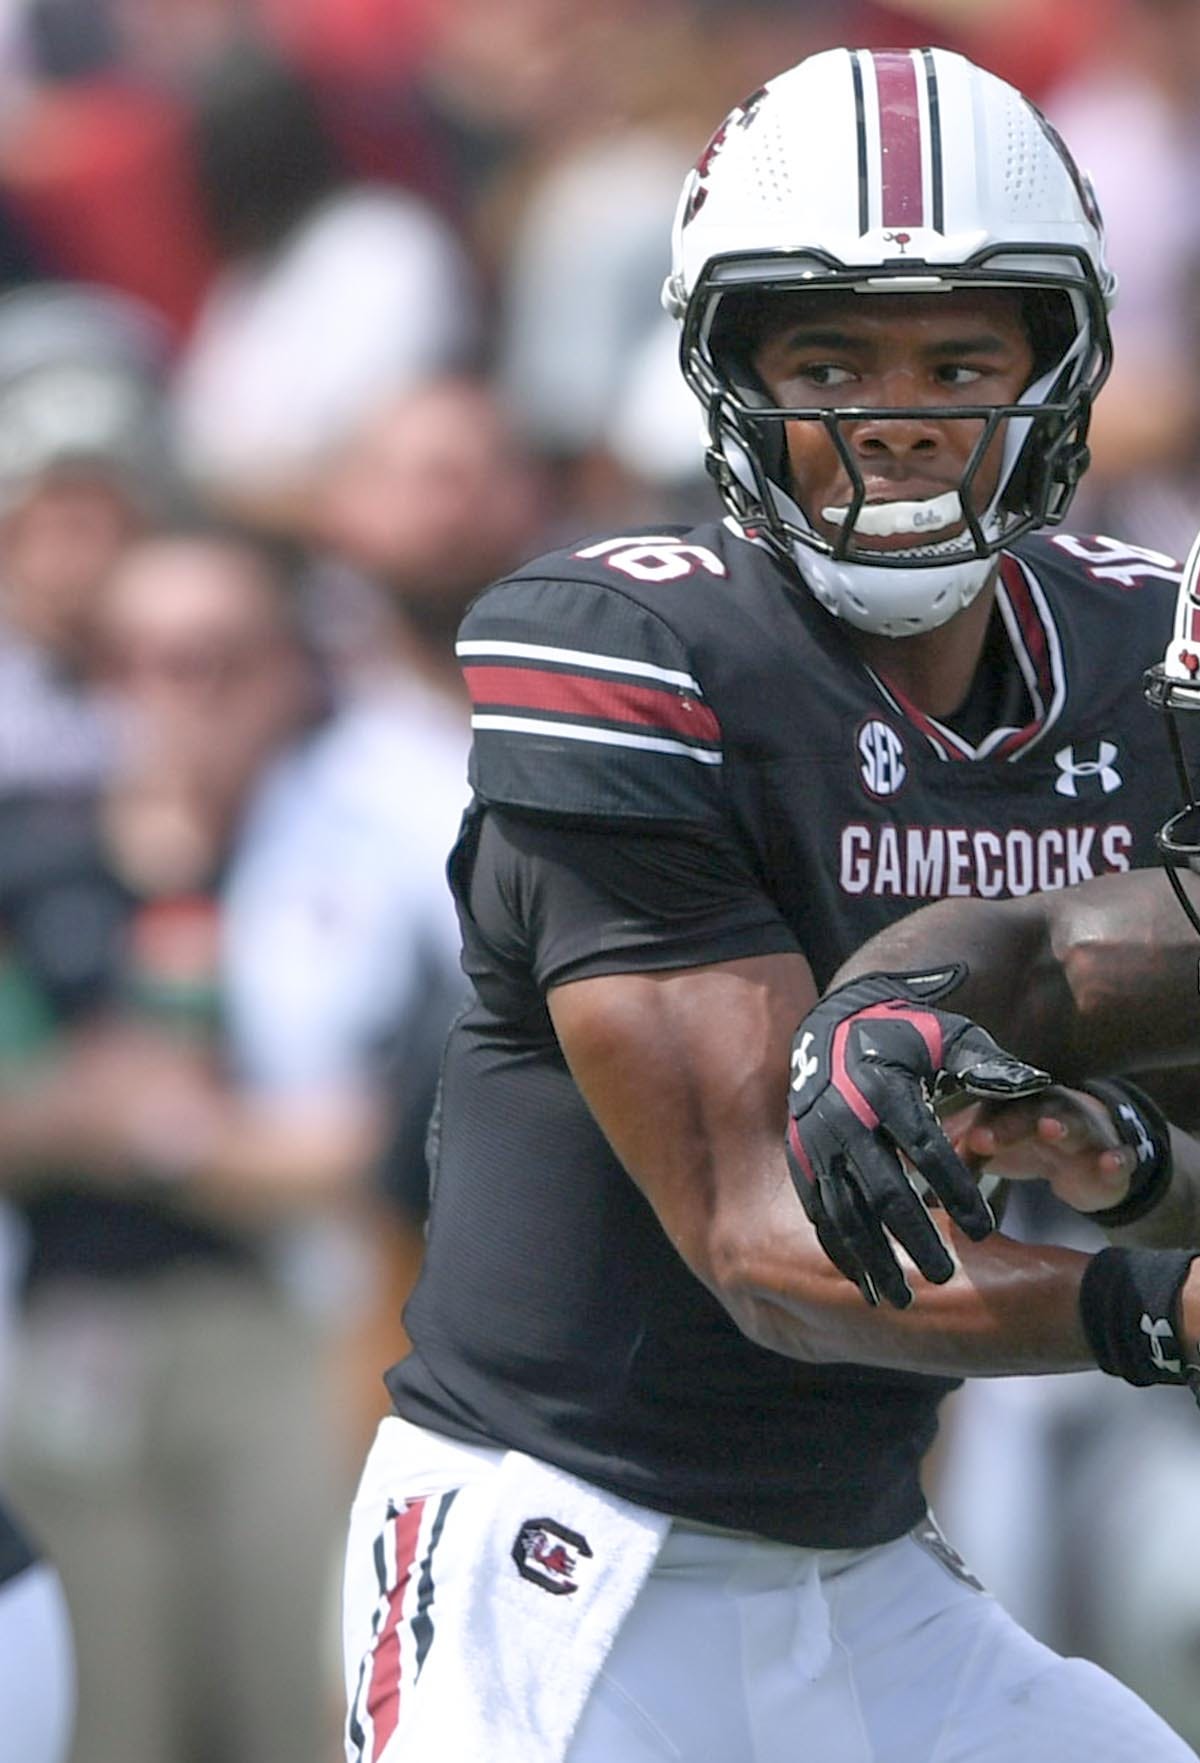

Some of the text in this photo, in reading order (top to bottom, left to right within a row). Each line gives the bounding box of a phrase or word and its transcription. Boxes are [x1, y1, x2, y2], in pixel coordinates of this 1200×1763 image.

[570, 535, 730, 582] 16
[858, 719, 907, 796] SEC
[839, 823, 1133, 898] GAMECOCKS
